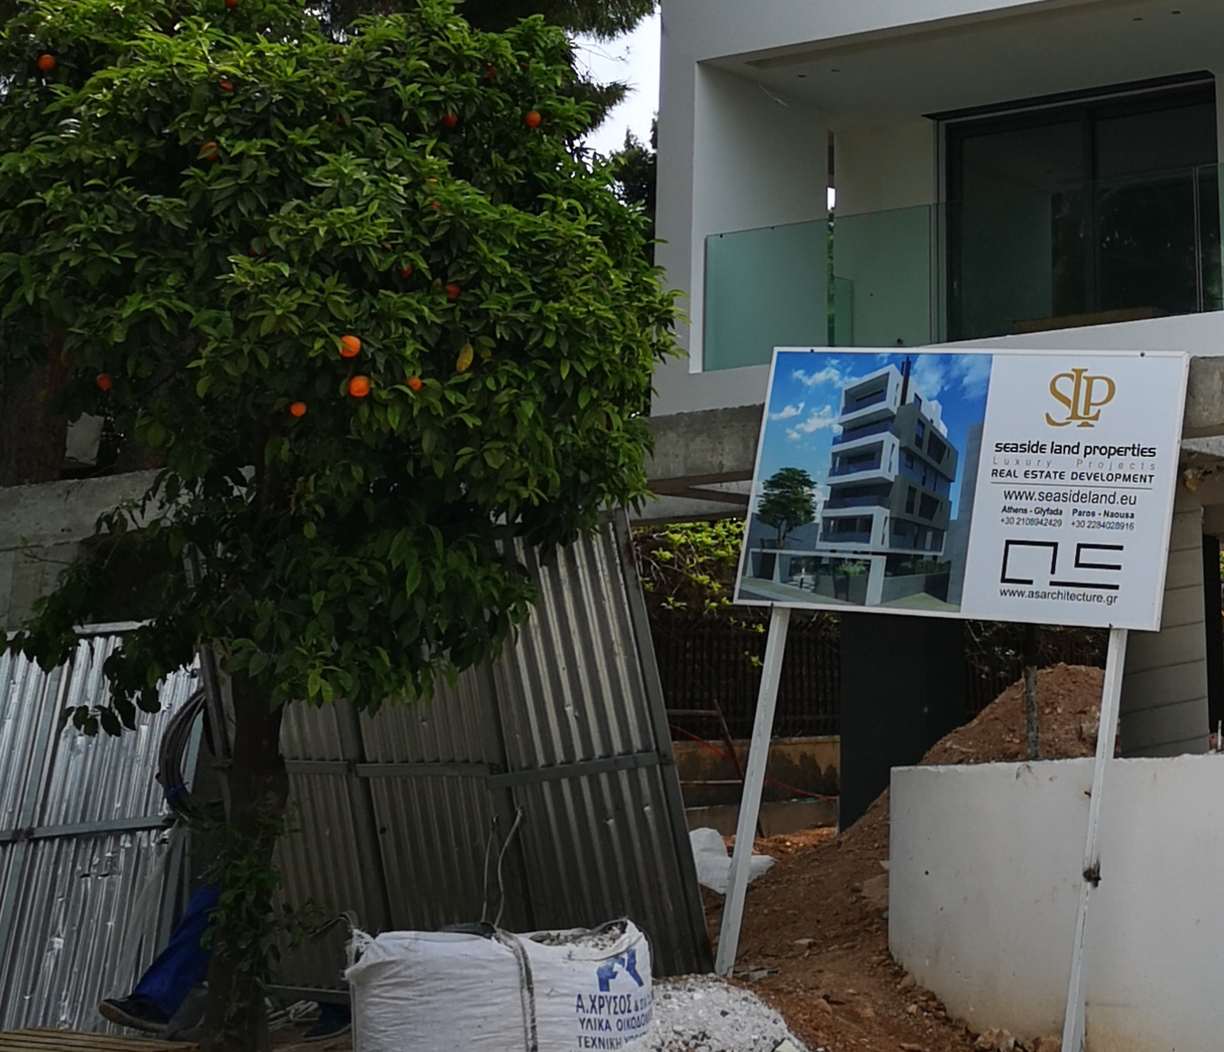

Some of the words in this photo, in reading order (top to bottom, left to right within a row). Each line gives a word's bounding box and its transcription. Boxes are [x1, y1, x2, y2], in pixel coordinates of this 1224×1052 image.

[994, 440, 1047, 454] seaside
[1050, 441, 1080, 455] land
[1083, 443, 1156, 459] properties
[993, 457, 1052, 468] Luxury
[1076, 459, 1156, 471] Projects
[991, 469, 1019, 479] REAL
[1023, 470, 1066, 480] ESTATE
[1070, 471, 1155, 484] DEVELOPMENT
[1003, 489, 1137, 506] www.seasideland.eu
[1001, 505, 1028, 514] Athens
[1034, 506, 1063, 517] Glyfada
[1072, 508, 1096, 518] Paros
[1103, 510, 1135, 519] Naousa
[1001, 517, 1015, 525] +30
[1071, 520, 1086, 529] +30
[999, 588, 1119, 606] www.asarchitecture.gr
[579, 1017, 612, 1032] ΥΛΙΚΑ
[577, 1035, 622, 1050] ΤΕΧΝΙΚΗ
